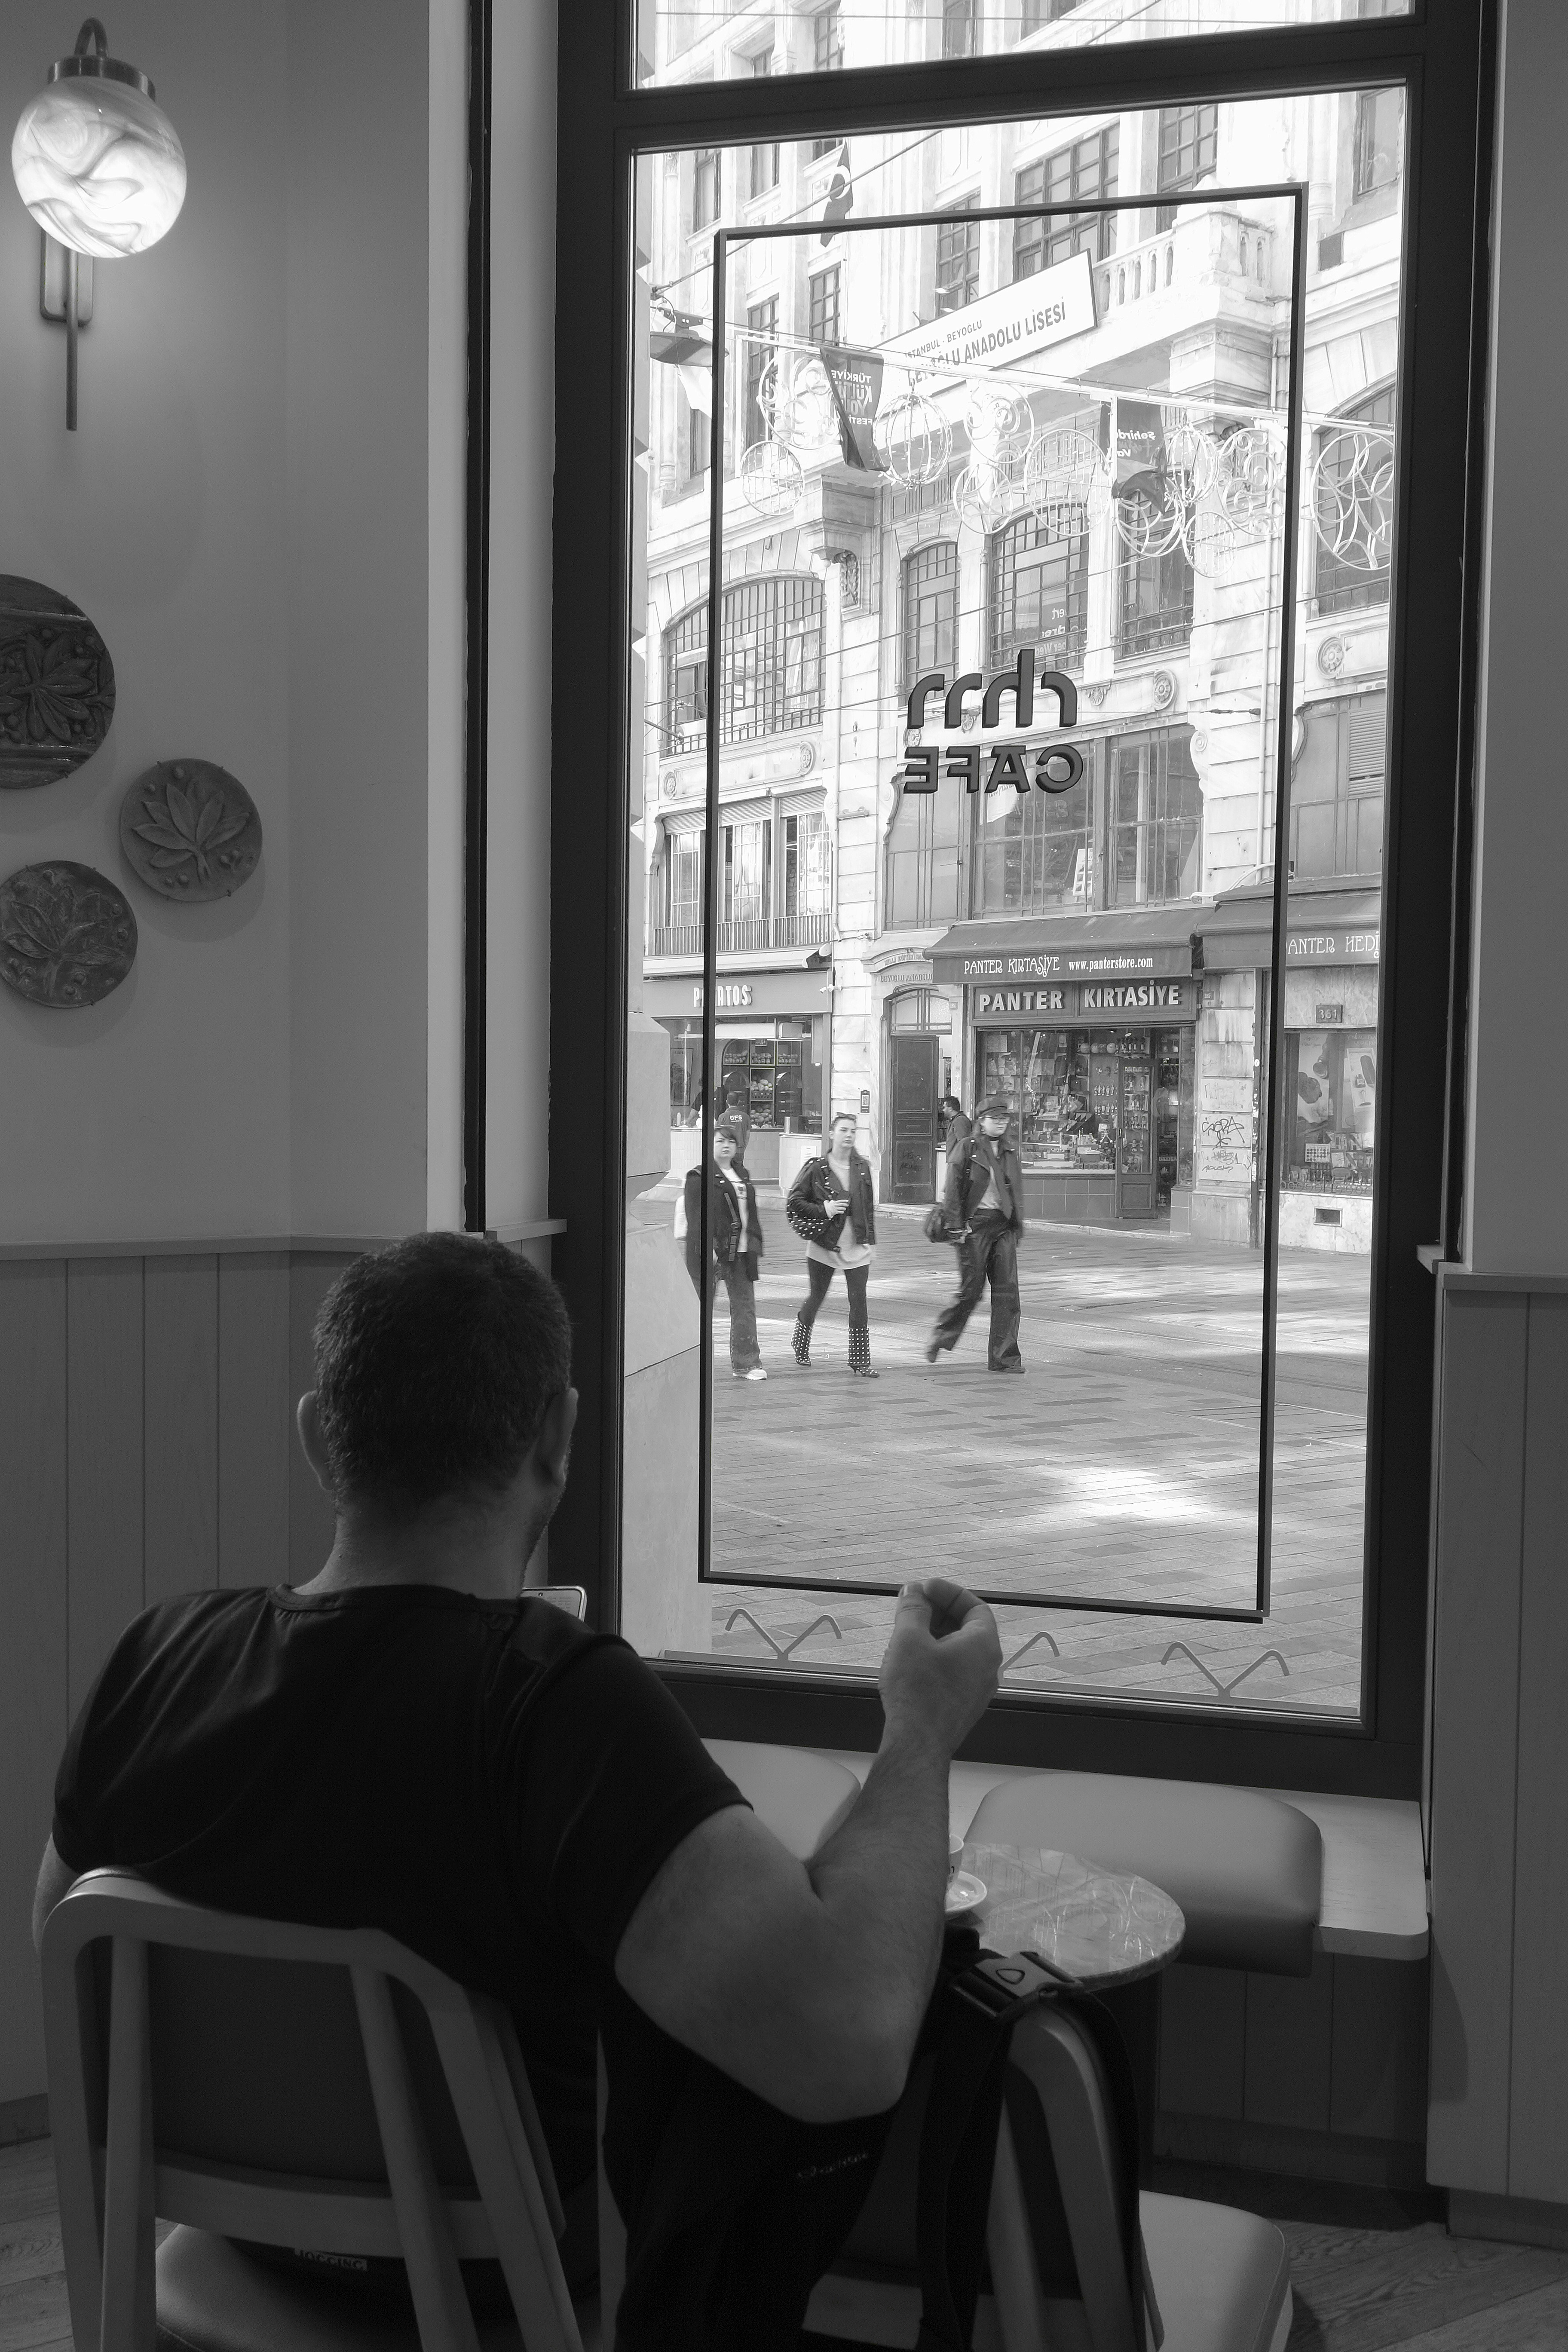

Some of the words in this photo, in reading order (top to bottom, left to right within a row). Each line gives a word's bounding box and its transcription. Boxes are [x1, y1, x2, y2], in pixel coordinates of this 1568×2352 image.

[965, 321, 1021, 363] ANADOLU
[1025, 296, 1066, 335] LİSESİ
[1286, 937, 1335, 954] ANTER
[1345, 931, 1379, 959] HEDİ
[964, 959, 1003, 974] PANTER
[1008, 954, 1060, 977] KIRTASİYE
[1069, 956, 1153, 972] www.panterstore.com
[693, 985, 752, 1007] PATOS
[980, 990, 1063, 1012] PANTER
[1084, 980, 1179, 1008] KIRTASİYE
[1318, 1009, 1338, 1020] 361
